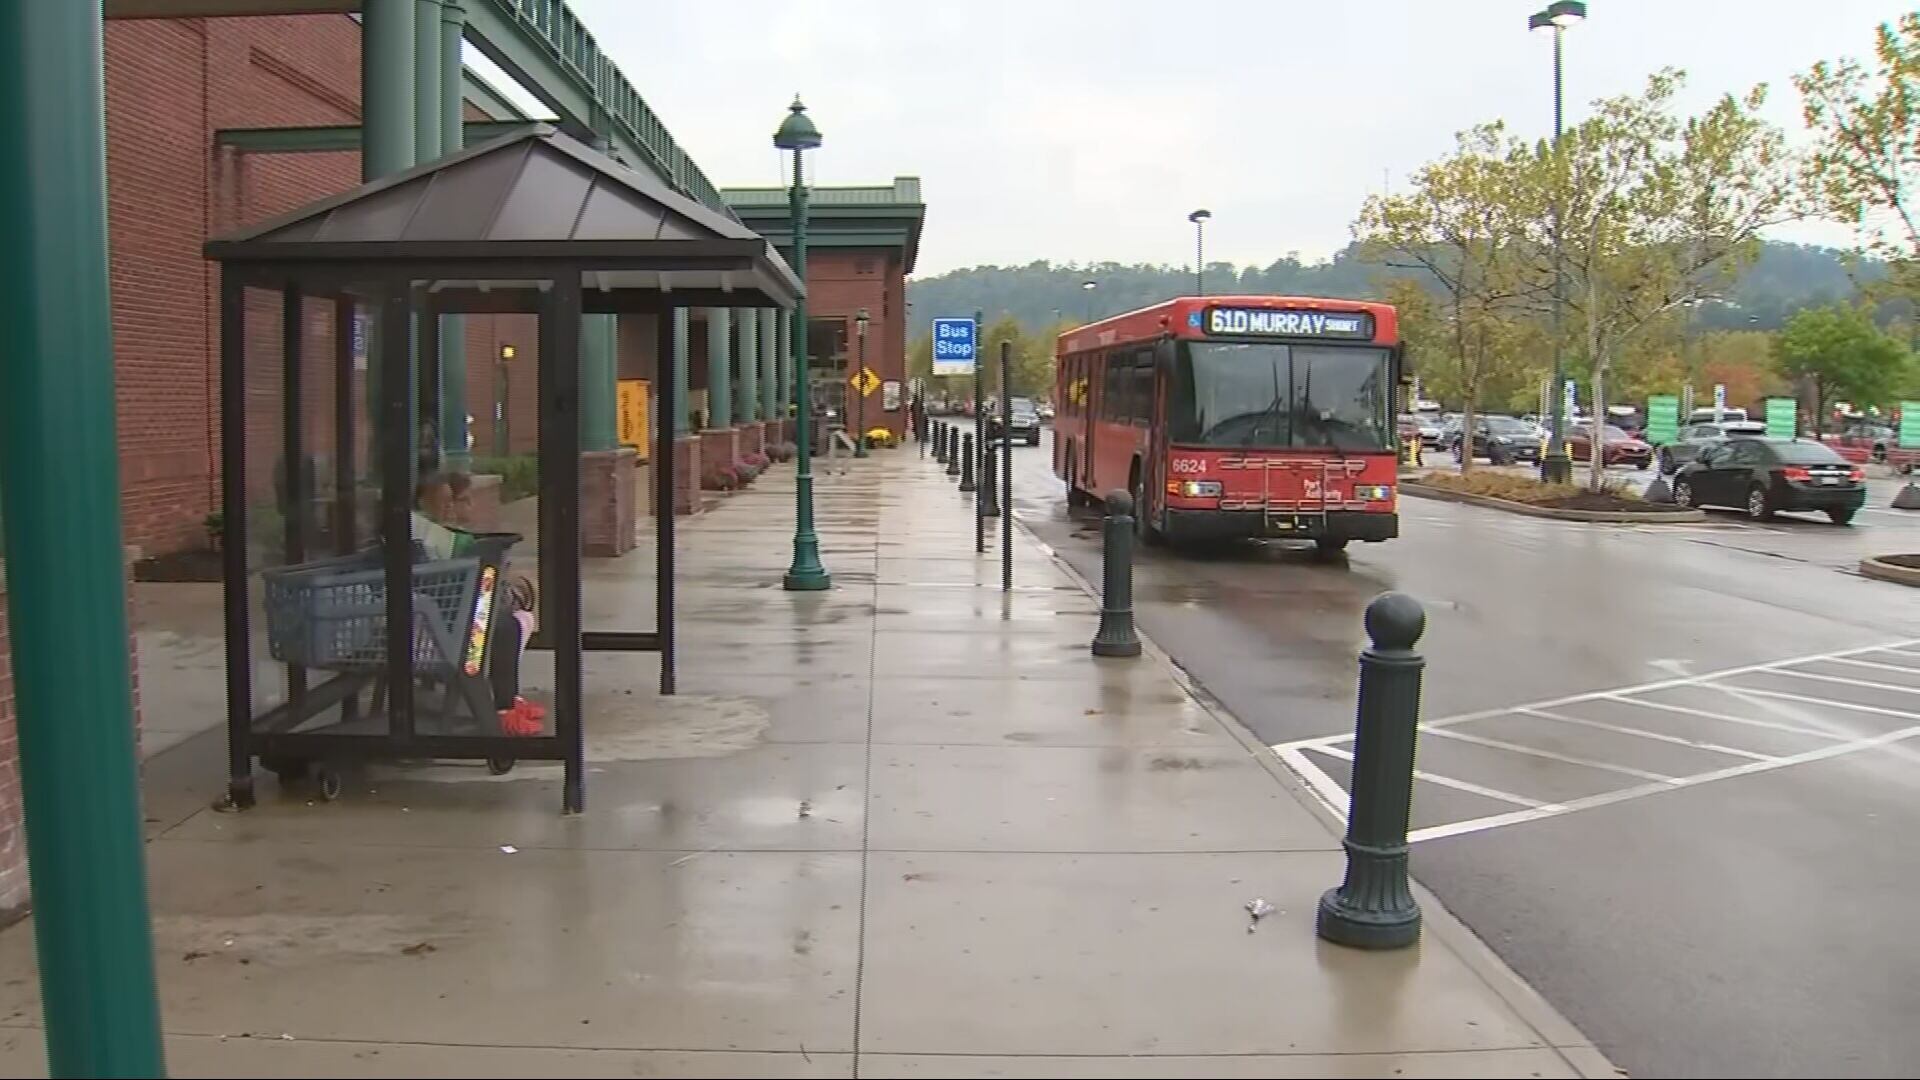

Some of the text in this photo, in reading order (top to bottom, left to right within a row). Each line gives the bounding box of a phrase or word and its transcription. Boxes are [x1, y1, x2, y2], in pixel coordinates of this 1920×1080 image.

[1211, 309, 1247, 333] 61D
[1250, 312, 1325, 334] MURRAY
[940, 323, 969, 338] Bus
[937, 339, 972, 357] Stop
[1172, 459, 1207, 473] 6624
